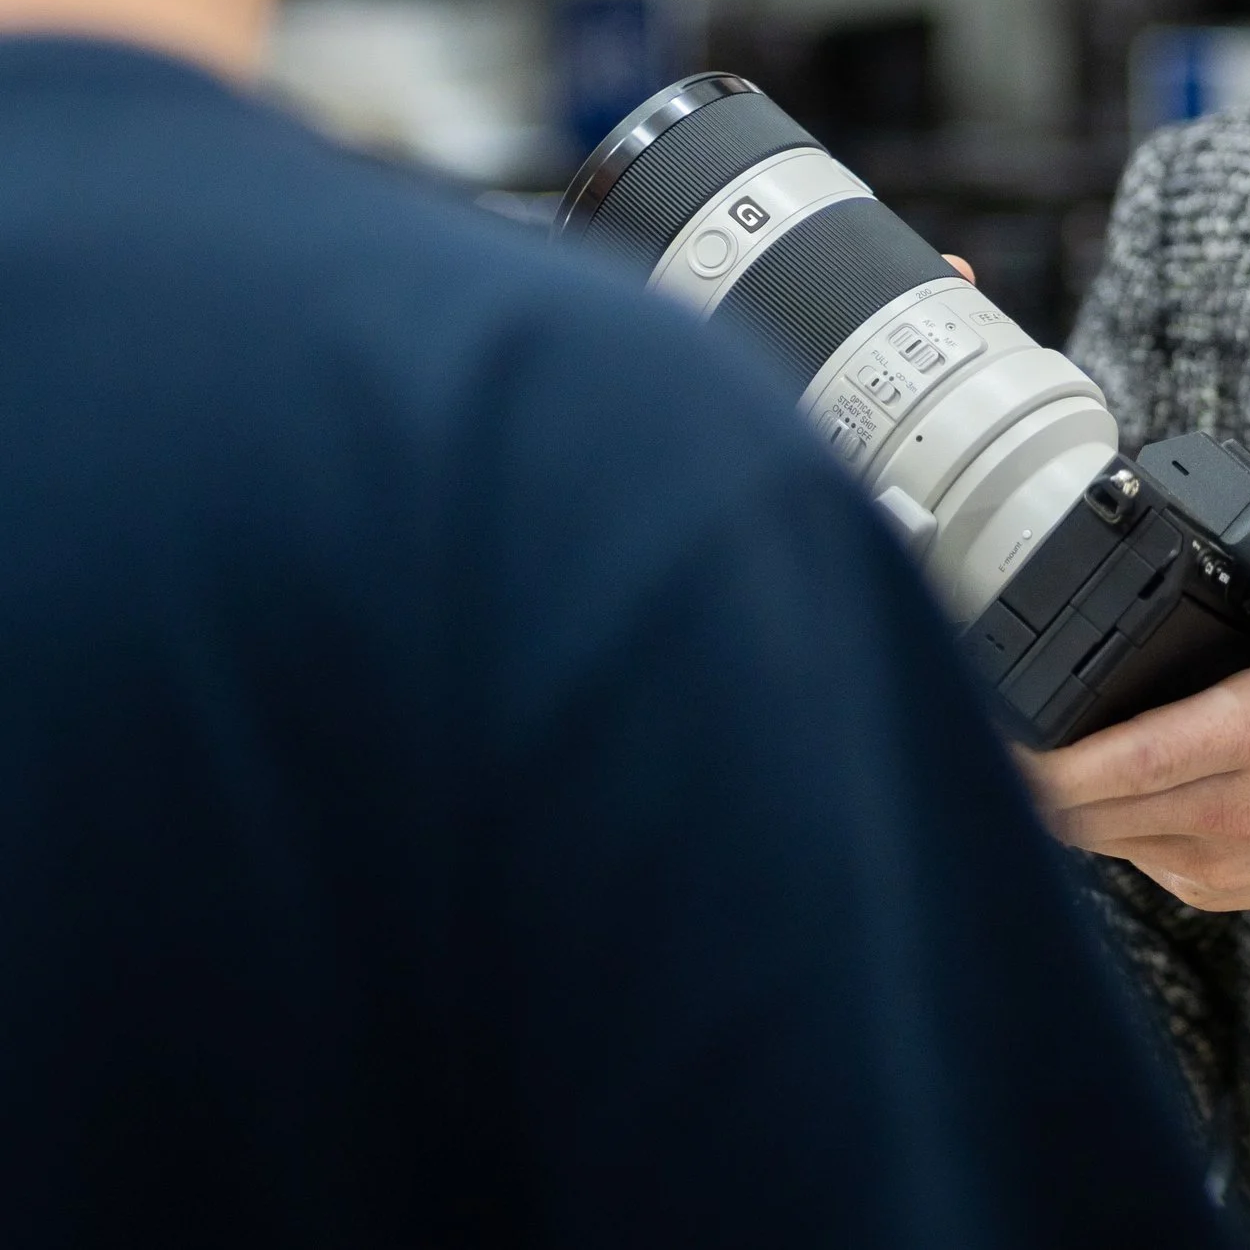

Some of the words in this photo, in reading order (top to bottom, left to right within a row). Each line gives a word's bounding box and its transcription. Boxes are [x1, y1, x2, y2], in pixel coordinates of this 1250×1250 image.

[736, 203, 764, 227] G
[914, 288, 932, 300] 200
[922, 319, 936, 329] AF
[943, 337, 958, 348] MF
[871, 349, 889, 368] FULL
[837, 395, 861, 418] STEADY
[860, 414, 877, 431] SHOT
[849, 394, 874, 419] OPTICAL
[832, 404, 845, 417] ON
[856, 426, 873, 441] OFF
[997, 541, 1023, 573] E-mount
